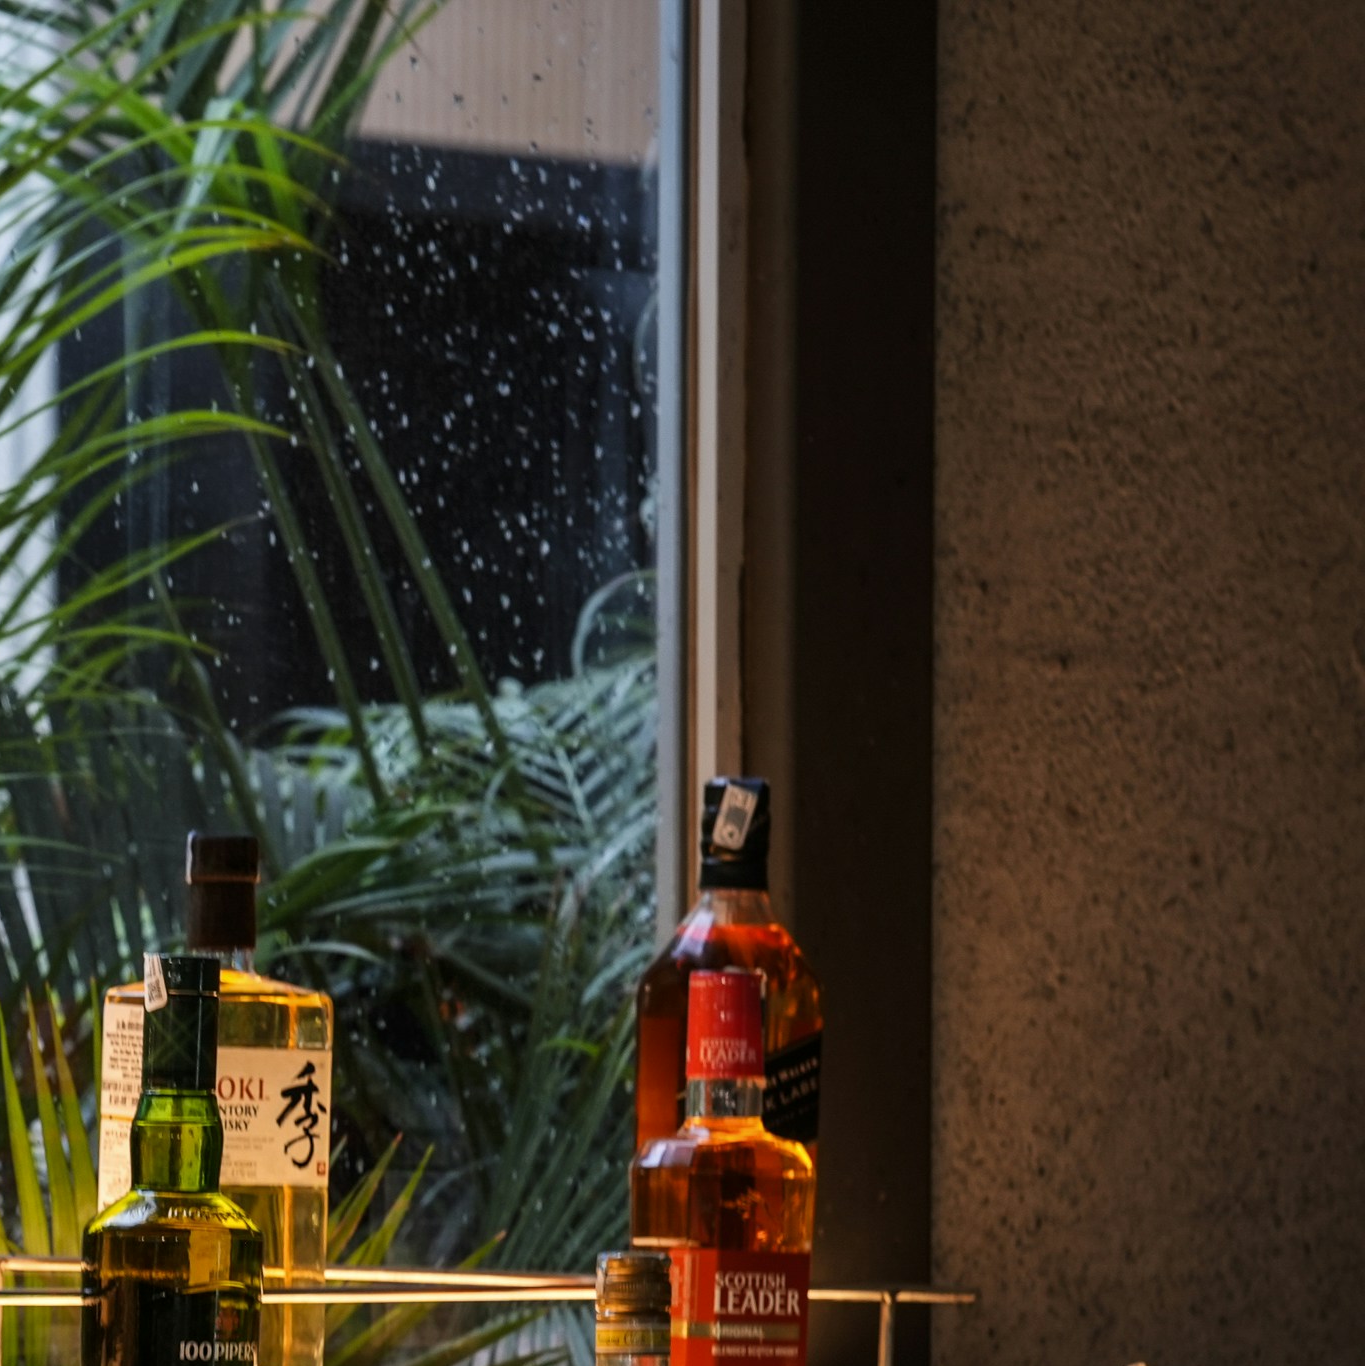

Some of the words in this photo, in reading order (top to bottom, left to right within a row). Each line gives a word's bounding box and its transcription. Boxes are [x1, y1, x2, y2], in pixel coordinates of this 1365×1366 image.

[218, 1076, 264, 1101] OKI
[276, 1060, 327, 1170] 季
[714, 1271, 787, 1289] SCOTTISH
[713, 1290, 801, 1316] LEADER
[711, 1324, 765, 1340] ORIGINAL
[179, 1340, 212, 1361] 100
[214, 1340, 257, 1361] PIPERS
